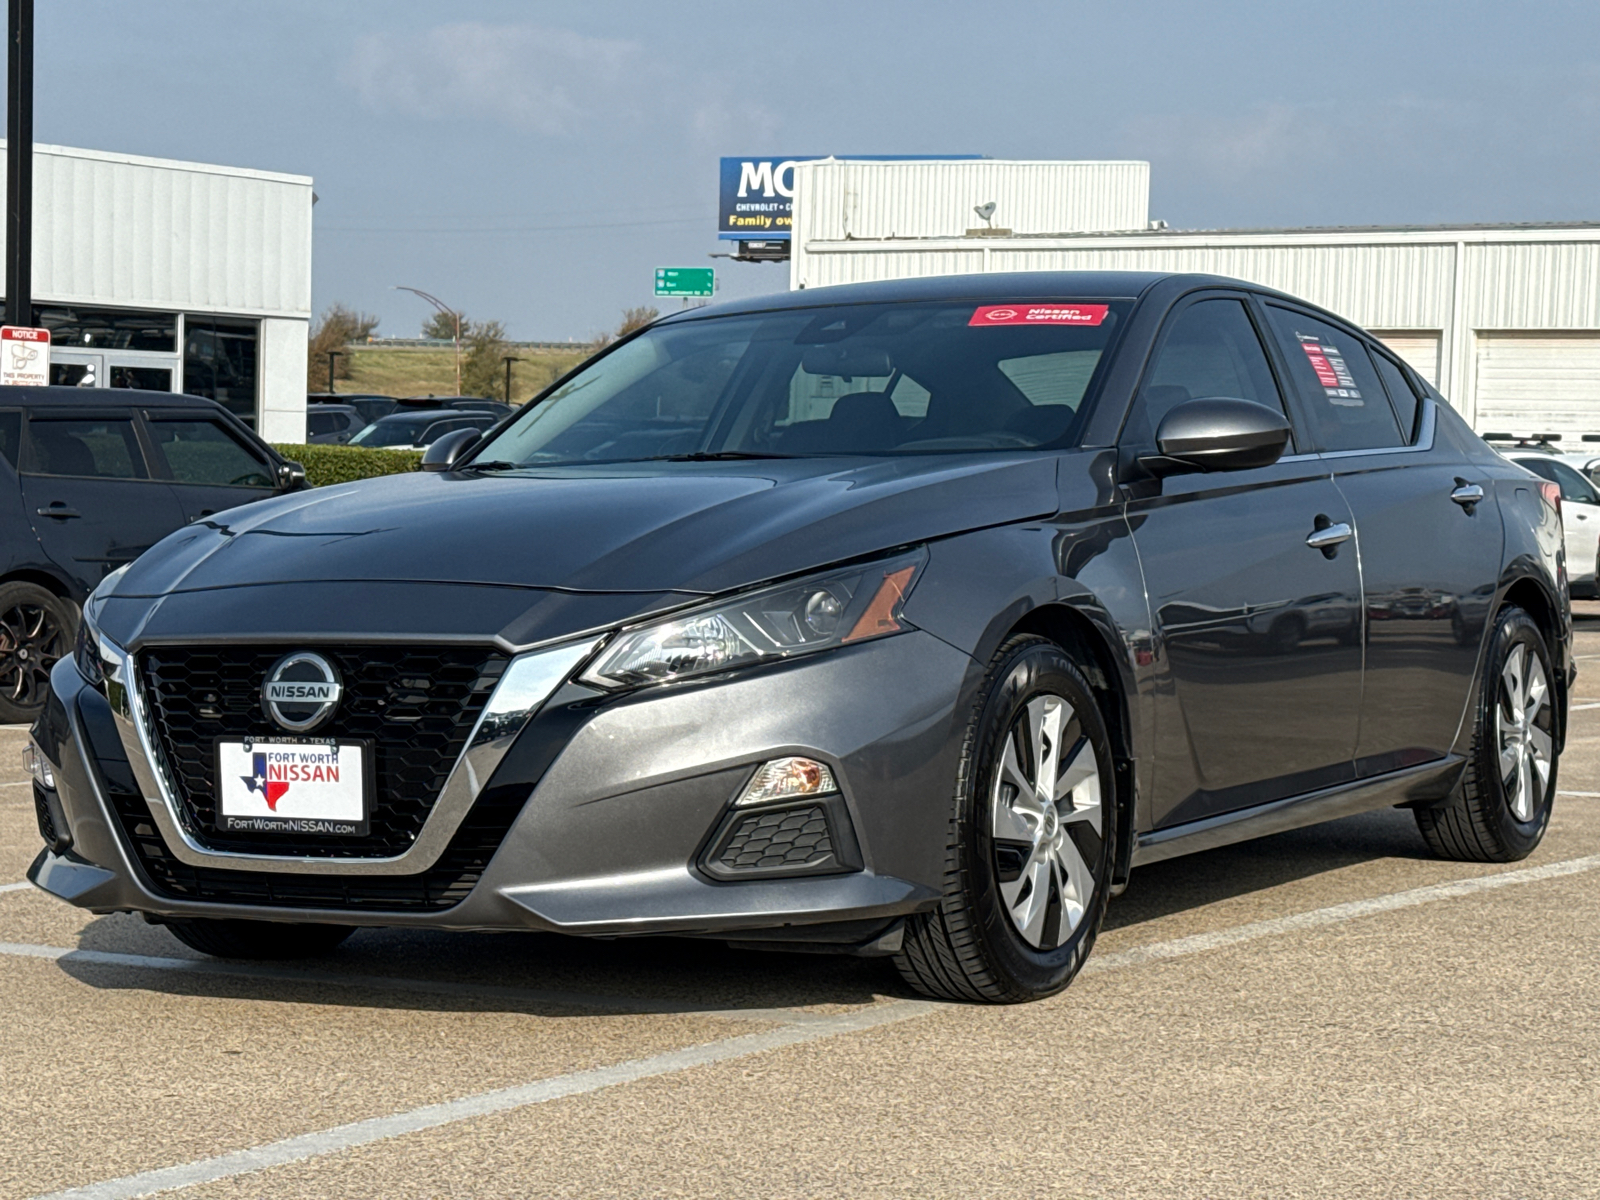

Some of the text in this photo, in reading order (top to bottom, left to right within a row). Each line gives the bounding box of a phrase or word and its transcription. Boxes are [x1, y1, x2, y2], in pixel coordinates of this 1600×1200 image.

[736, 203, 778, 212] CHEVROLET
[729, 215, 773, 228] Family
[12, 330, 39, 340] NOTICE
[270, 686, 330, 698] NISSAN
[268, 752, 339, 764] FORT WORTH
[268, 764, 340, 783] NISSAN
